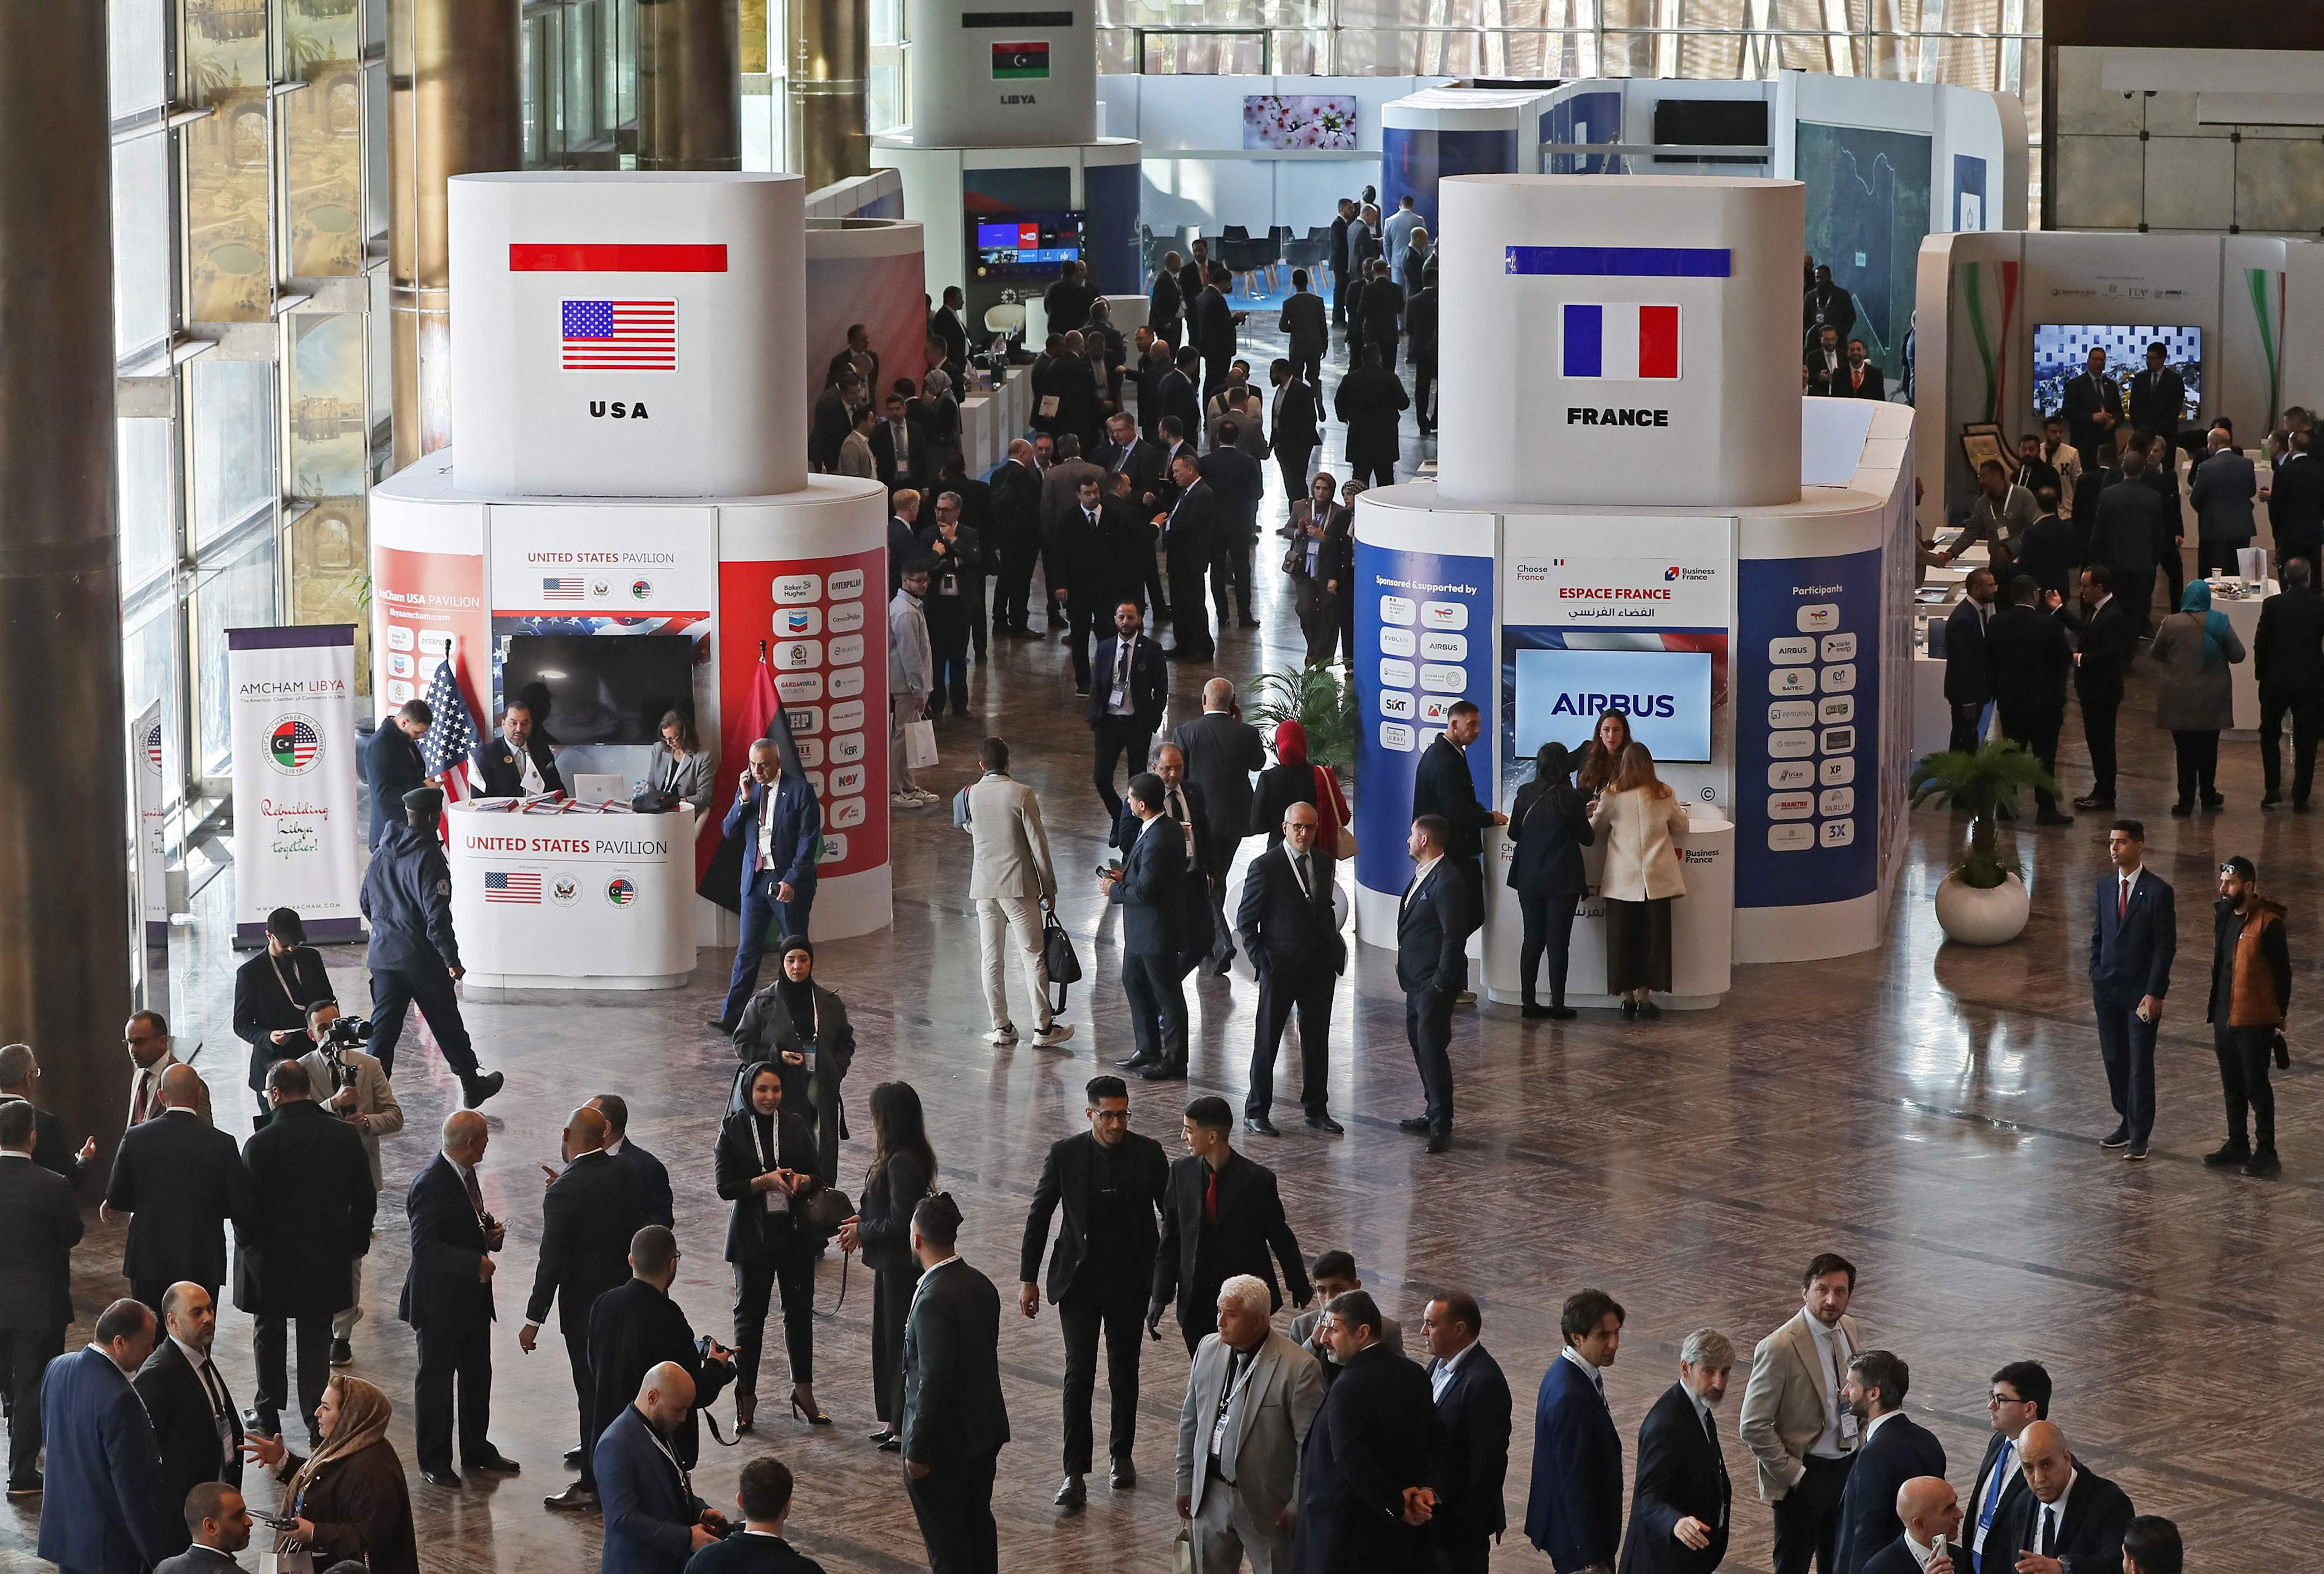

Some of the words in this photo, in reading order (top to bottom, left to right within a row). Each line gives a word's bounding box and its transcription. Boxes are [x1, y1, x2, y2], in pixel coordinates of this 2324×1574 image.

[1000, 95, 1036, 105] LIBYA
[590, 401, 649, 419] USA
[1567, 408, 1669, 427] FRANCE
[2061, 463, 2069, 475] K
[528, 553, 573, 562] UNITED
[577, 553, 619, 563] STATES
[623, 553, 674, 563] PAVILION
[831, 579, 861, 590] CATERPILLAR
[1376, 575, 1411, 589] Sponsored
[1465, 584, 1477, 595] by
[1792, 584, 1843, 596] Participants
[378, 588, 405, 603] AmCham
[407, 593, 426, 604] USA
[428, 595, 480, 608] PAVILION
[1559, 588, 1612, 599] ESPACE
[1615, 589, 1671, 600] FRANCE
[833, 614, 860, 623] ConocoPhillips
[1568, 608, 1614, 620] الفرنسي
[1618, 608, 1655, 617] الفضاء
[1384, 635, 1408, 643] EVOLEN
[1429, 643, 1458, 651] AIRBUS
[239, 681, 304, 695] AMCHAM
[309, 680, 345, 692] LIBYA
[1550, 693, 1675, 718] AIRBUS
[263, 730, 275, 764] AMERICAN
[271, 715, 301, 729] CHAMBER
[312, 724, 324, 761] COMMERCE
[844, 745, 858, 756] KBR
[1829, 765, 1841, 775] XP
[261, 799, 330, 821] Rebuilding
[1825, 804, 1850, 812] FARLYM
[277, 818, 314, 840] Libya
[1829, 824, 1846, 838] 3X
[270, 838, 318, 860] together!
[466, 835, 526, 852] UNITED
[532, 838, 590, 853] STATES
[595, 840, 667, 854] PAVILION
[825, 840, 838, 850] slb
